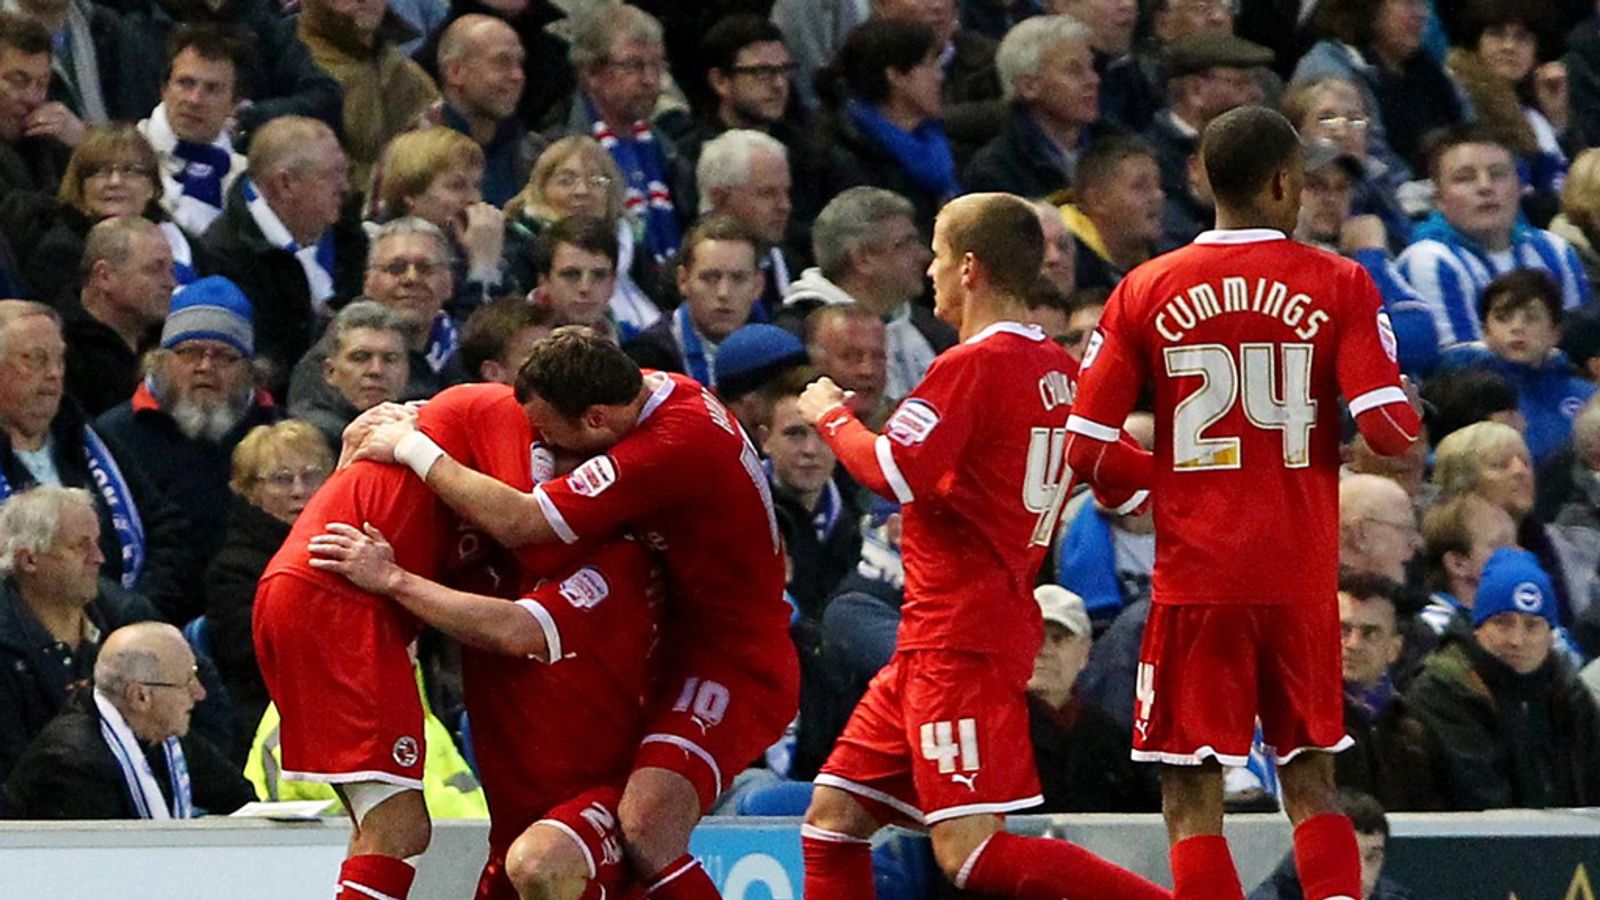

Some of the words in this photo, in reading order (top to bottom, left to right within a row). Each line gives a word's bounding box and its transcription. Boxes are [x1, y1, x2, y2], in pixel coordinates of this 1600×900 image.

[1155, 277, 1329, 341] CUMMINGS
[1163, 343, 1318, 471] 24
[672, 677, 729, 726] 10
[920, 718, 979, 774] 41
